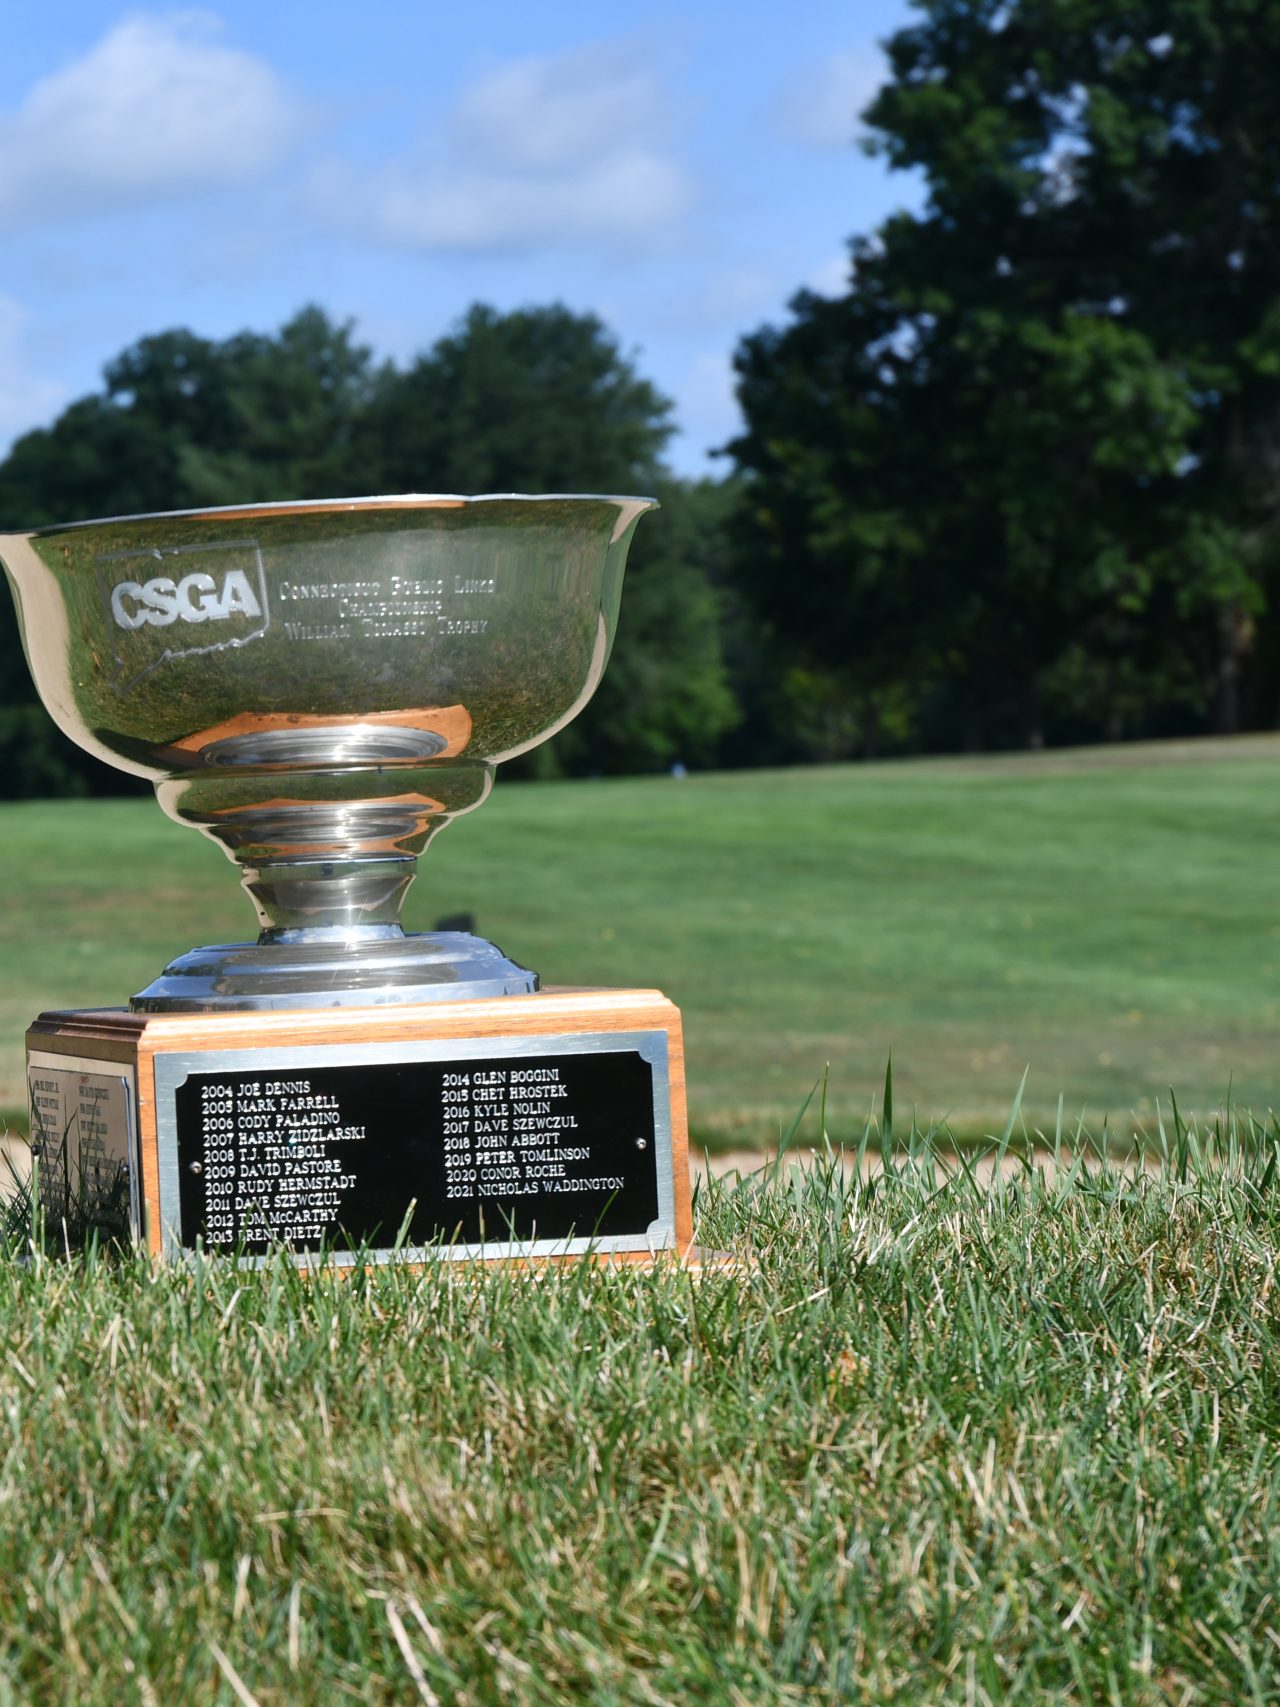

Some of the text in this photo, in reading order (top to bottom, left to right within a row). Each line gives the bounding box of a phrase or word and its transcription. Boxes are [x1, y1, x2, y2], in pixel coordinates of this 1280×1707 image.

[111, 570, 262, 631] CSGA
[442, 1069, 559, 1086] 2014 GLEN BOGGINI
[202, 1081, 310, 1098] 2004 JOE DENNIS
[441, 1085, 568, 1102] 2015 CHET HROSTEK
[202, 1096, 339, 1114] 2005 MARK FARRELL
[443, 1102, 551, 1119] 2016 KYLE NOLIN
[203, 1112, 340, 1131] 2006 CODY PALADINO
[443, 1116, 578, 1134] 2017 DAVE SZEWCZUL
[204, 1126, 365, 1146] 2007 HARRY ZIDZLARSKI
[444, 1132, 560, 1150] 2018 JOHN ABBOTT
[204, 1145, 325, 1163] 2008 T.J. TRIMBOLI
[445, 1147, 590, 1167] 2019 PETER TOMLINSON
[205, 1160, 341, 1179] 2009 DAVID PASTORE
[446, 1164, 566, 1182] 2020 CONOR ROCHE
[205, 1175, 356, 1195] 2010 RUDY HERMSTADT
[447, 1177, 624, 1198] 2021 NICHOLAS WADDINGTON
[206, 1192, 341, 1211] 2011 DAVE SZEWCZUL
[207, 1208, 338, 1227] 2012 TOM McCARTHY
[206, 1229, 233, 1244] 2013
[284, 1225, 321, 1239] DIETZ
